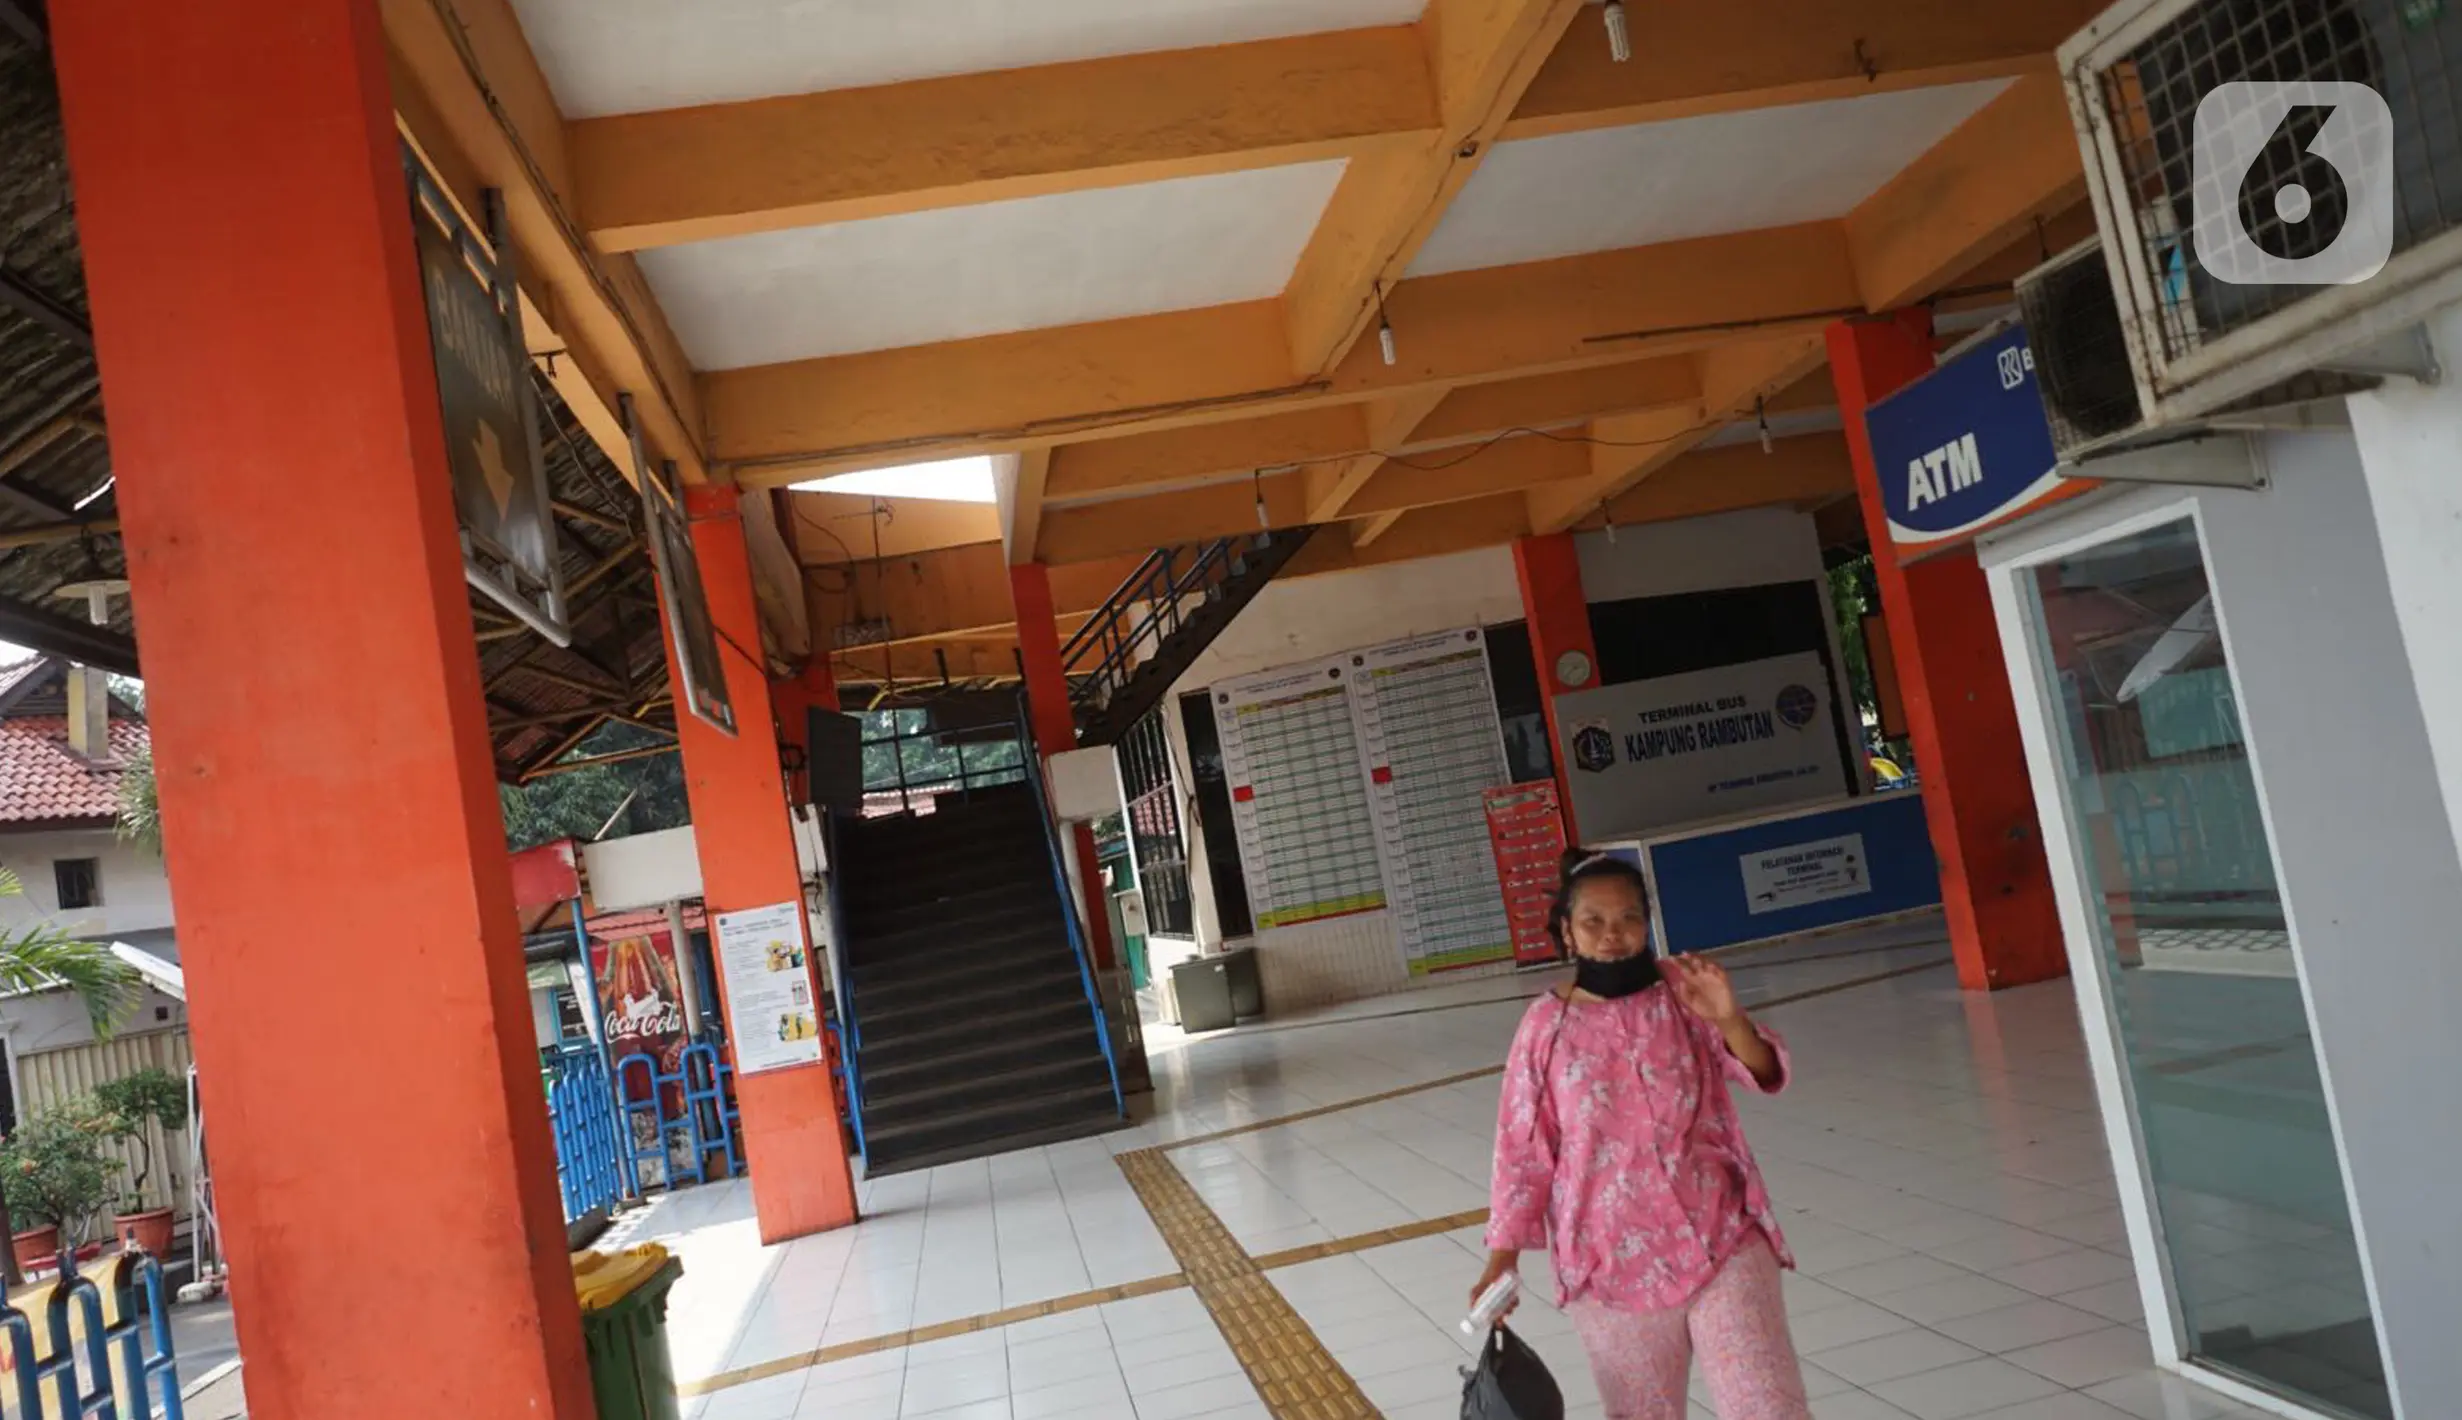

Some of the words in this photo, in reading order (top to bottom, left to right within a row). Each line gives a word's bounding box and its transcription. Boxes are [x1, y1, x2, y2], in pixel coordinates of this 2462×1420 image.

[1908, 433, 1982, 511] ATM
[1638, 702, 1714, 724] TERMINAL
[1717, 695, 1747, 710] BUS
[1624, 725, 1696, 762] KAMPUNG
[1697, 710, 1774, 750] RAMBUTAN
[605, 1002, 679, 1043] Coca-Cola
